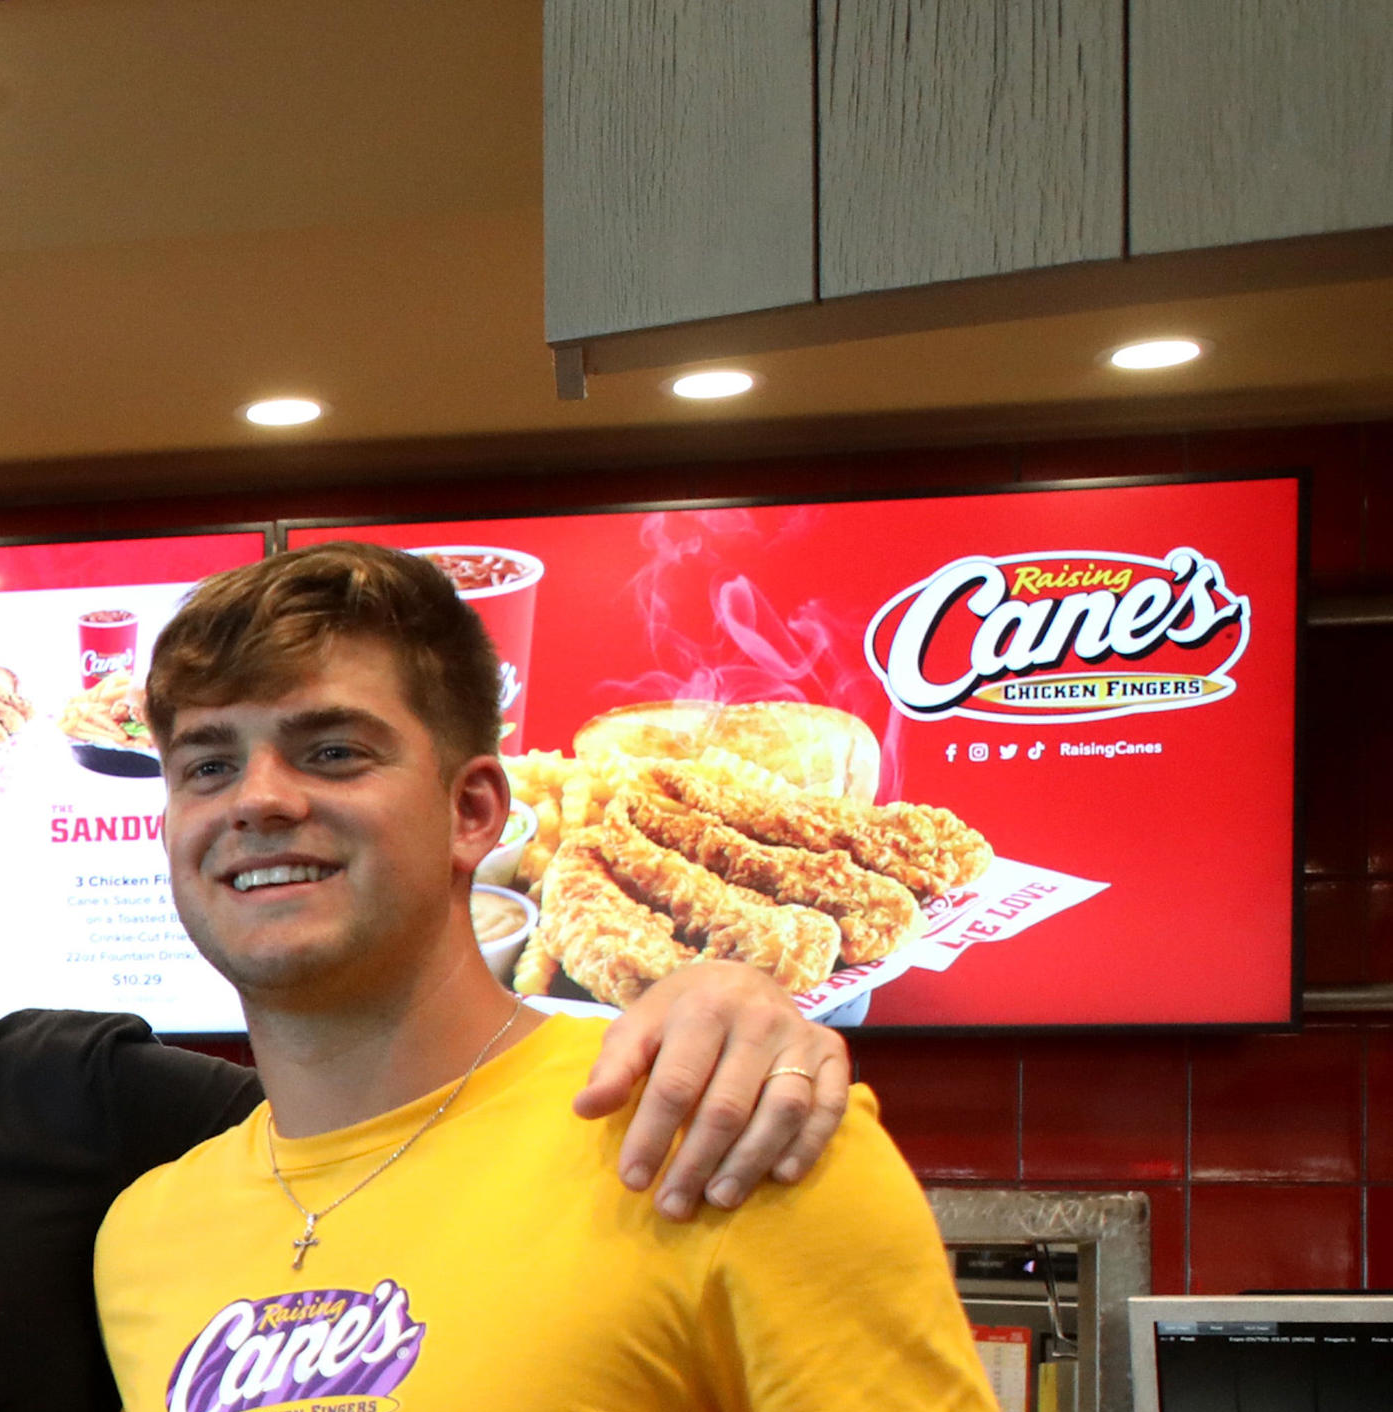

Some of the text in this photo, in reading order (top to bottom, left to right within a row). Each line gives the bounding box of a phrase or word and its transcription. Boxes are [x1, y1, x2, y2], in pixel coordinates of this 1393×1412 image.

[1011, 563, 1133, 596] Raising
[887, 553, 1241, 708] Cane's
[1003, 679, 1202, 700] CHICKEN FINGERS
[1059, 740, 1163, 758] RaisingCanes
[51, 815, 164, 842] SANDW
[75, 876, 84, 887] 3
[88, 874, 150, 888] Chicken
[988, 880, 1061, 920] LOVE
[112, 974, 163, 986] $10.29
[257, 1297, 347, 1332] Raising
